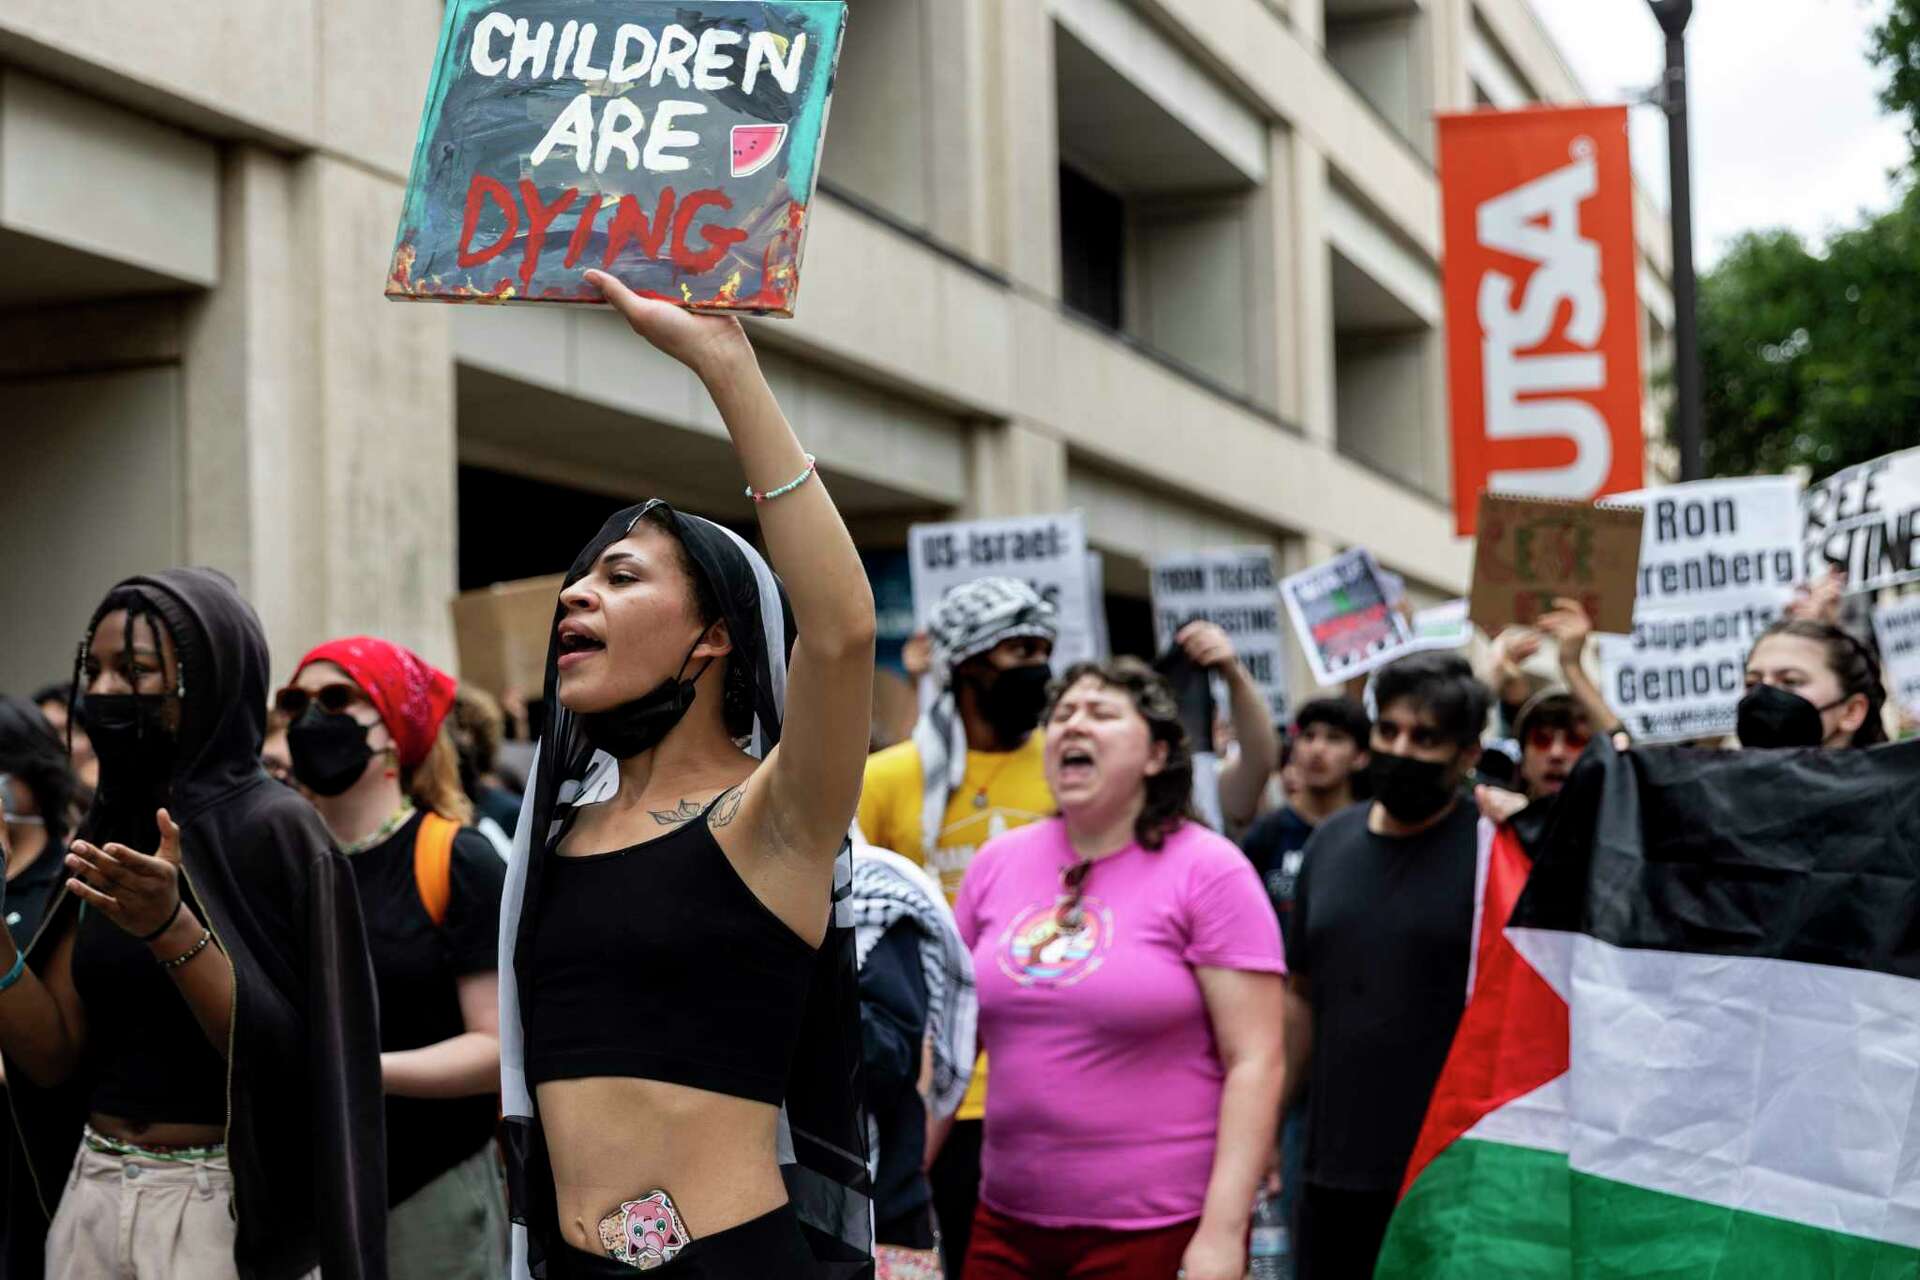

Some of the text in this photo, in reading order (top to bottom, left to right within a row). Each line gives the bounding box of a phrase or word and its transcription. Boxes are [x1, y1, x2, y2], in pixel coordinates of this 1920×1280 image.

[470, 12, 806, 94] CHILDREN
[530, 94, 708, 173] ARE
[457, 175, 749, 294] DYING
[1476, 158, 1613, 499] UTSA
[1655, 496, 1738, 543] Ron
